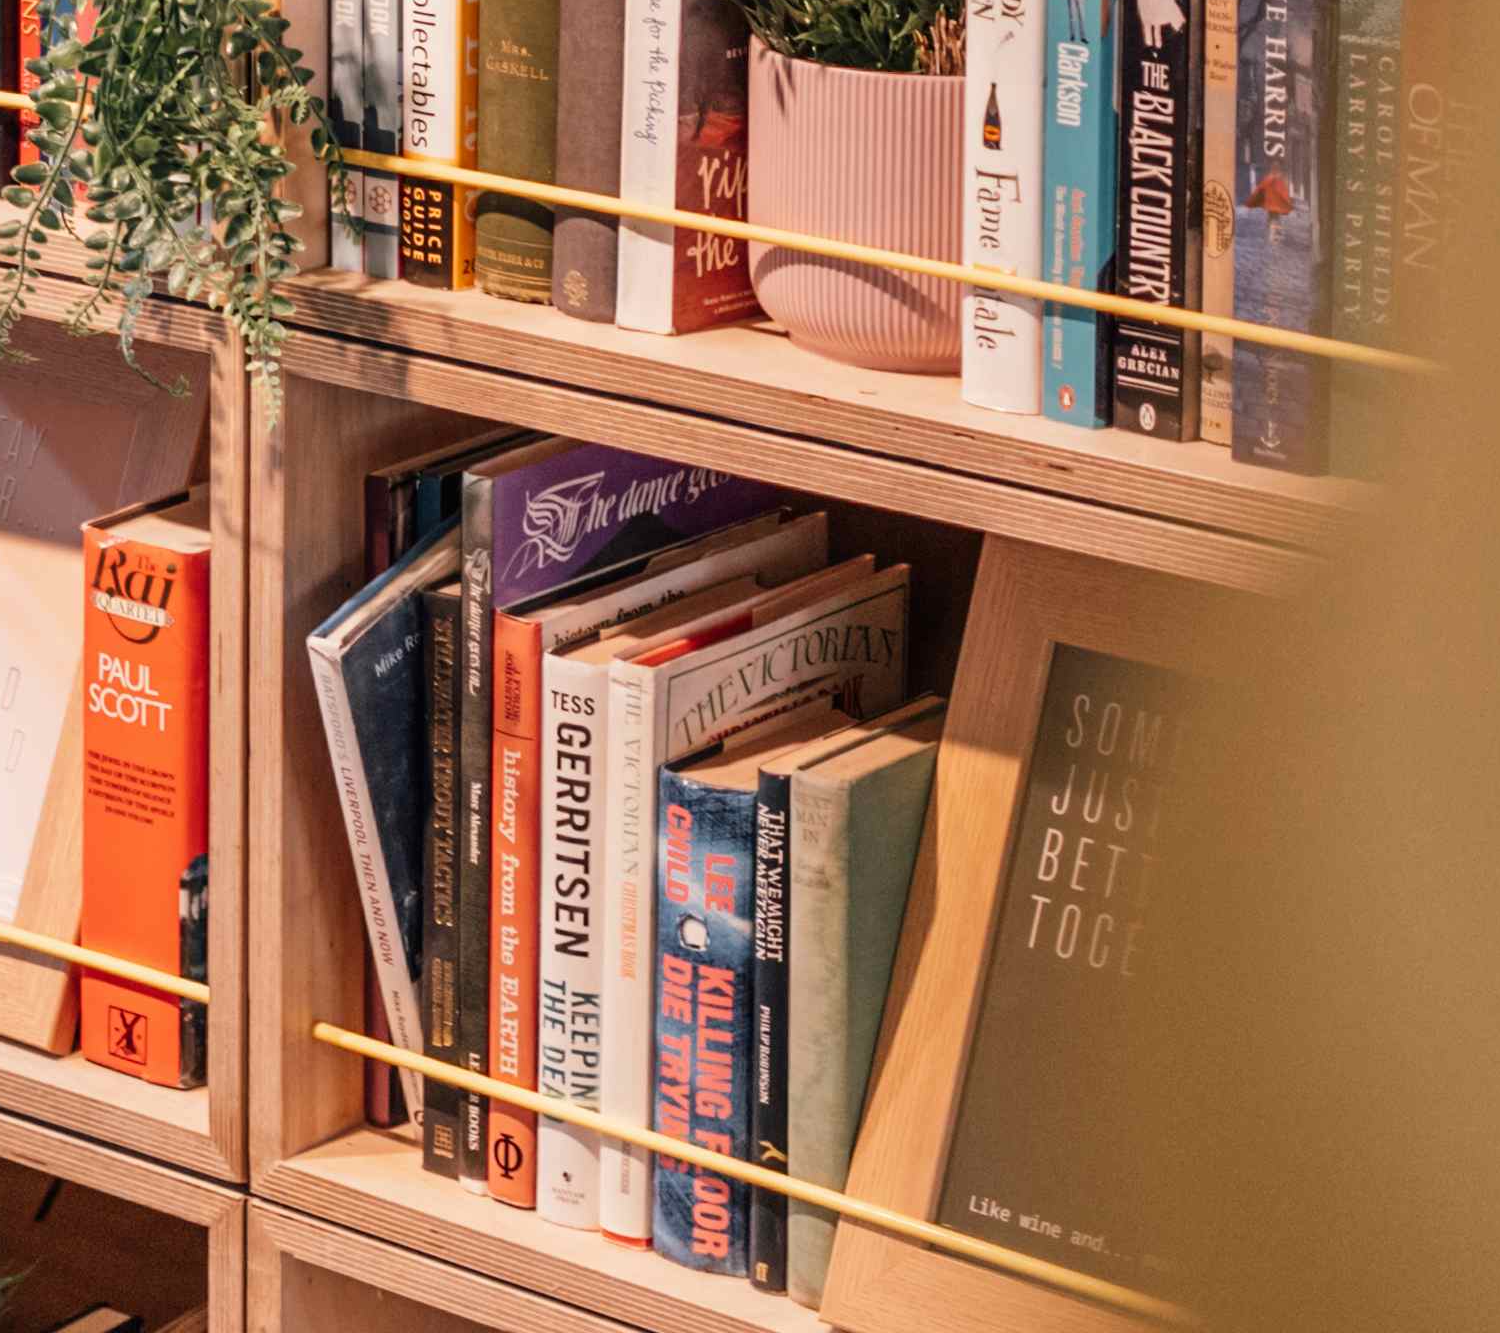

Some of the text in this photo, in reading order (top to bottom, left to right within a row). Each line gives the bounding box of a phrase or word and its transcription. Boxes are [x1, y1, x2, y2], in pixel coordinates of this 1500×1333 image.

[1056, 40, 1090, 128] Clarkson
[1262, 30, 1288, 159] HARRIS
[1130, 59, 1175, 188] THE BLACK
[412, 185, 426, 262] GUIDE
[427, 190, 443, 266] PRICE
[975, 165, 1022, 251] Fame
[1371, 53, 1398, 327] CAROL SHIELDS
[1342, 213, 1364, 319] PARTY
[1116, 354, 1180, 382] GRECIAN
[1130, 341, 1168, 362] ALEX
[95, 593, 163, 625] QUARTET
[88, 683, 173, 732] SCOTT
[98, 652, 158, 696] PAUL
[551, 689, 596, 718] TESS
[341, 765, 395, 967] LIVERPOOL THEN AND NOW
[554, 721, 593, 960] GERRITSEN
[662, 803, 693, 904] CHILD
[498, 745, 523, 1079] history from the EARTH
[703, 852, 737, 915] LEE
[543, 977, 567, 1021] THE
[661, 951, 693, 1007] DIE
[692, 966, 737, 1114] KILLING
[969, 1196, 1063, 1240] Like wine
